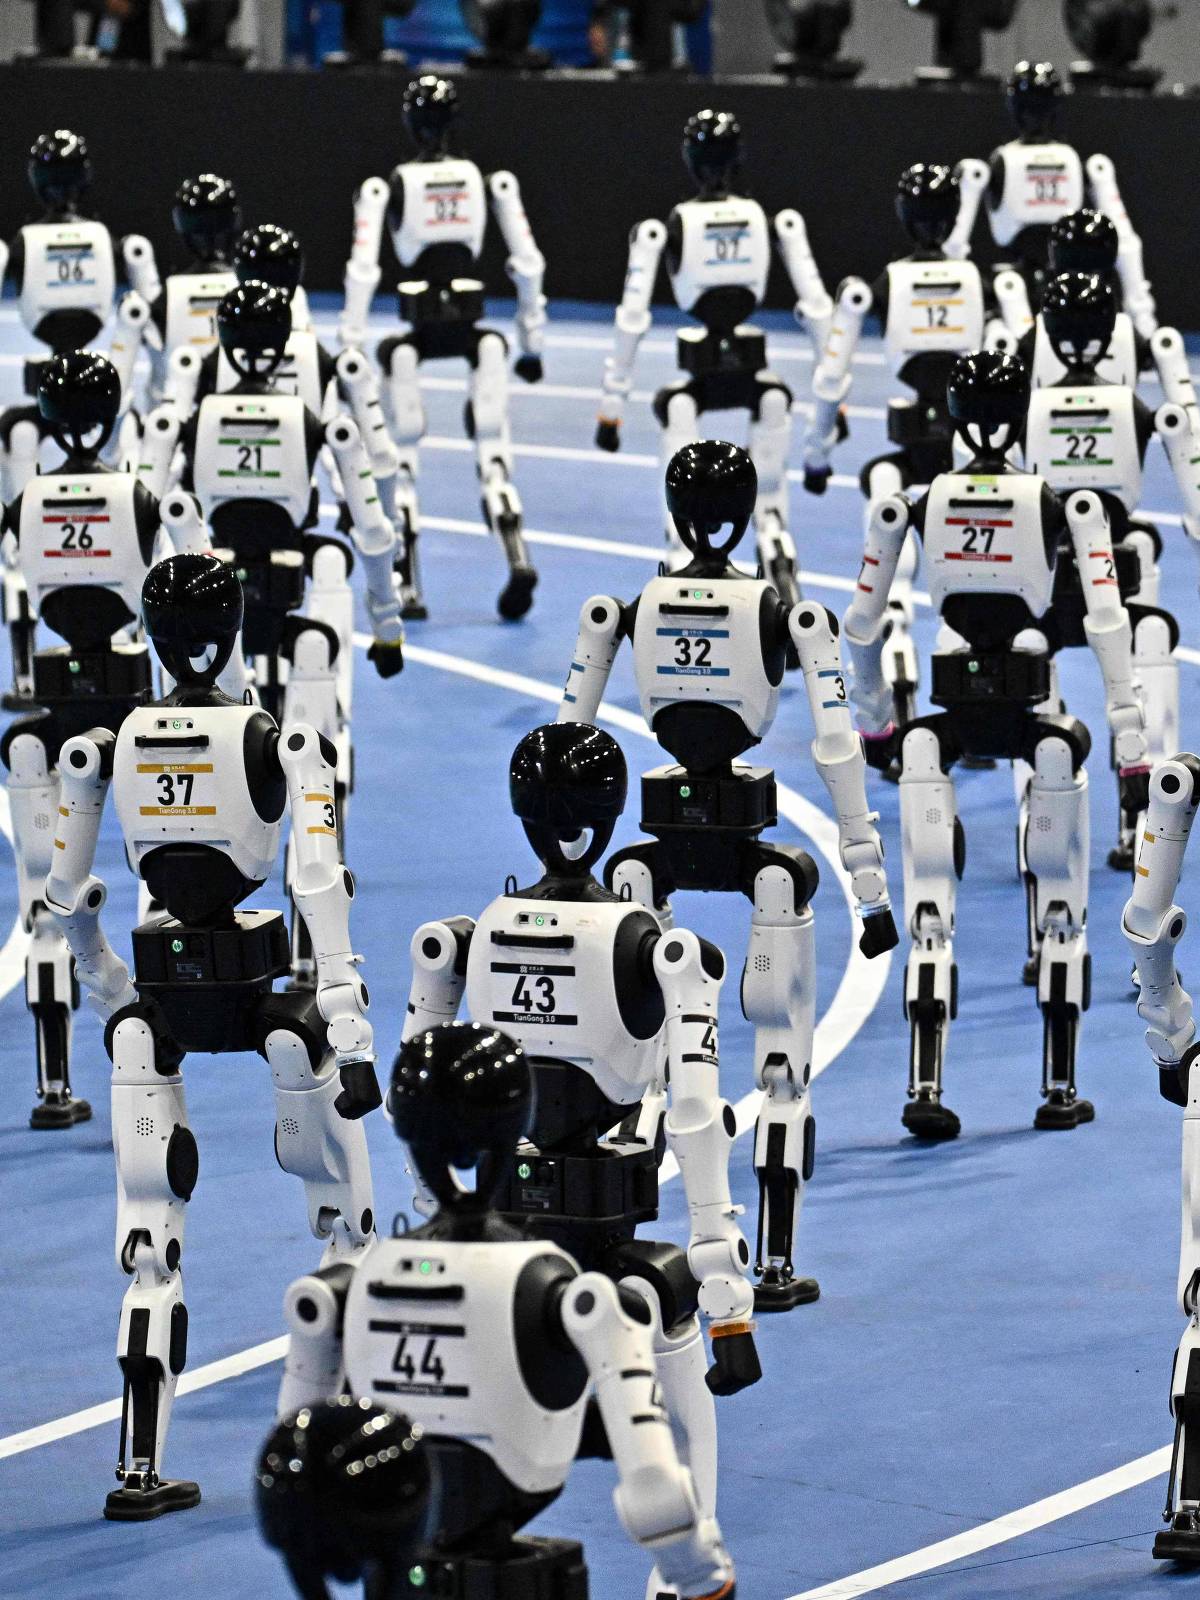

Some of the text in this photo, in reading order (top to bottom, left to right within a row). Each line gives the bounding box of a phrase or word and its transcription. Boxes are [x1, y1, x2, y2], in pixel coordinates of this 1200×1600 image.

[928, 304, 948, 328] 12
[237, 446, 262, 470] 21
[1066, 435, 1098, 459] 22
[61, 524, 92, 550] 26
[961, 527, 995, 553] 27
[1104, 559, 1114, 579] 2
[674, 638, 712, 667] 32
[834, 677, 846, 700] 3
[156, 774, 195, 806] 37
[323, 803, 336, 829] 3
[511, 974, 557, 1014] 43
[513, 1013, 557, 1024] TianGong 3.0
[701, 1025, 716, 1055] 4
[392, 1336, 445, 1386] 44
